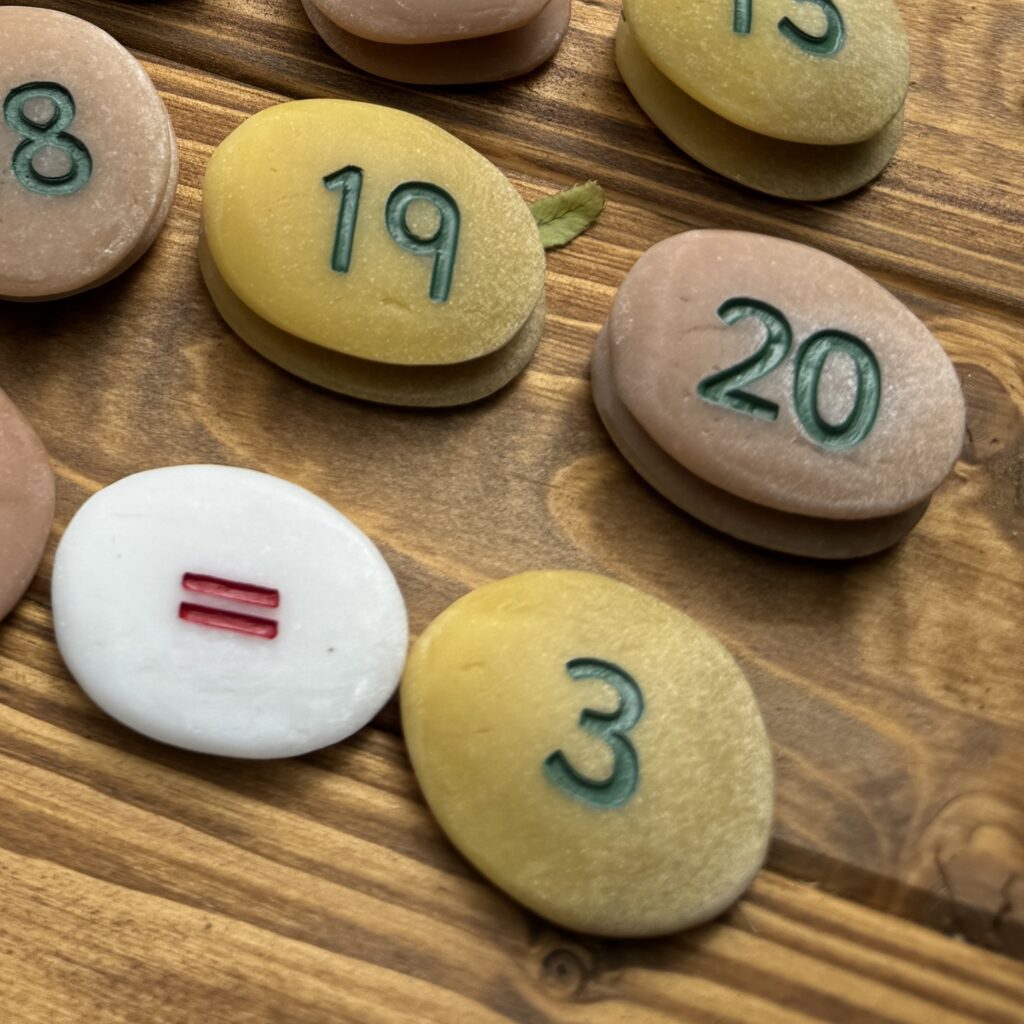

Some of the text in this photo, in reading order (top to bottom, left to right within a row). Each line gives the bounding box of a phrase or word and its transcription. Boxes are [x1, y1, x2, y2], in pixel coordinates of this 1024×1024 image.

[322, 165, 461, 303] 19
[697, 297, 882, 446] 20
[179, 572, 280, 640] =
[544, 658, 644, 807] 3
